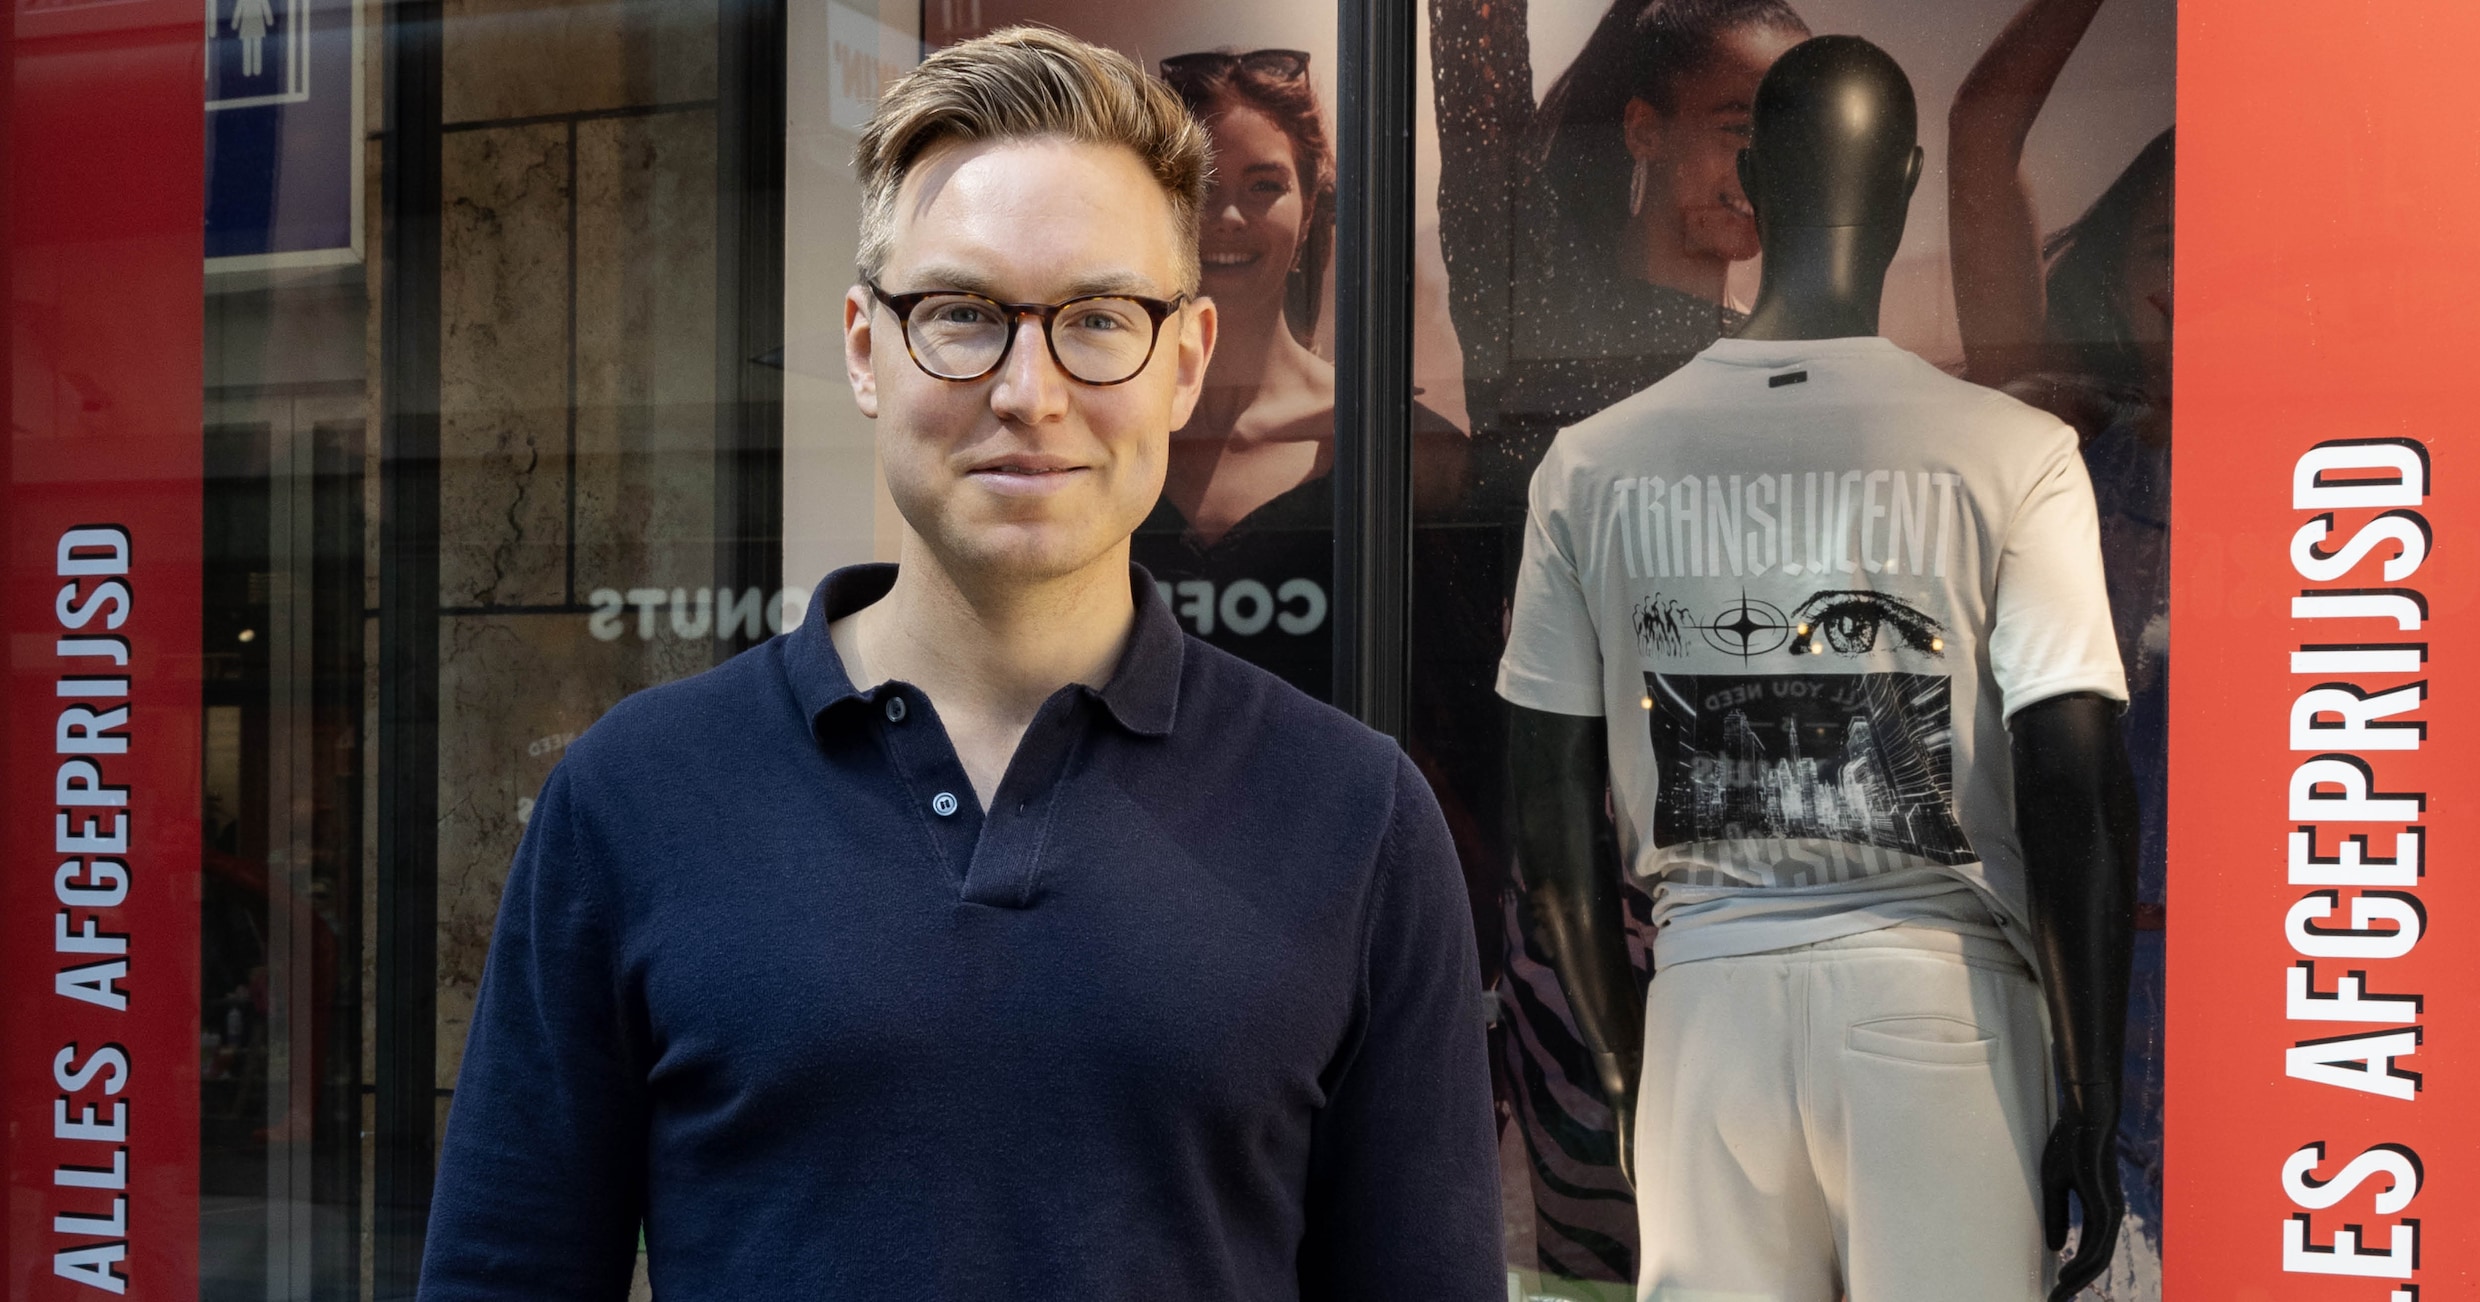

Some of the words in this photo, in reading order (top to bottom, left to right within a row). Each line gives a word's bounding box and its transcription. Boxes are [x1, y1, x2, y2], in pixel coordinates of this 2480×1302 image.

[1613, 470, 1961, 578] TRANSLUCENT
[55, 522, 134, 1011] AFGEPRIJSD
[2285, 437, 2431, 1101] AFGEPRIJSD
[54, 1041, 132, 1294] ALLES
[2282, 1141, 2424, 1302] ES
